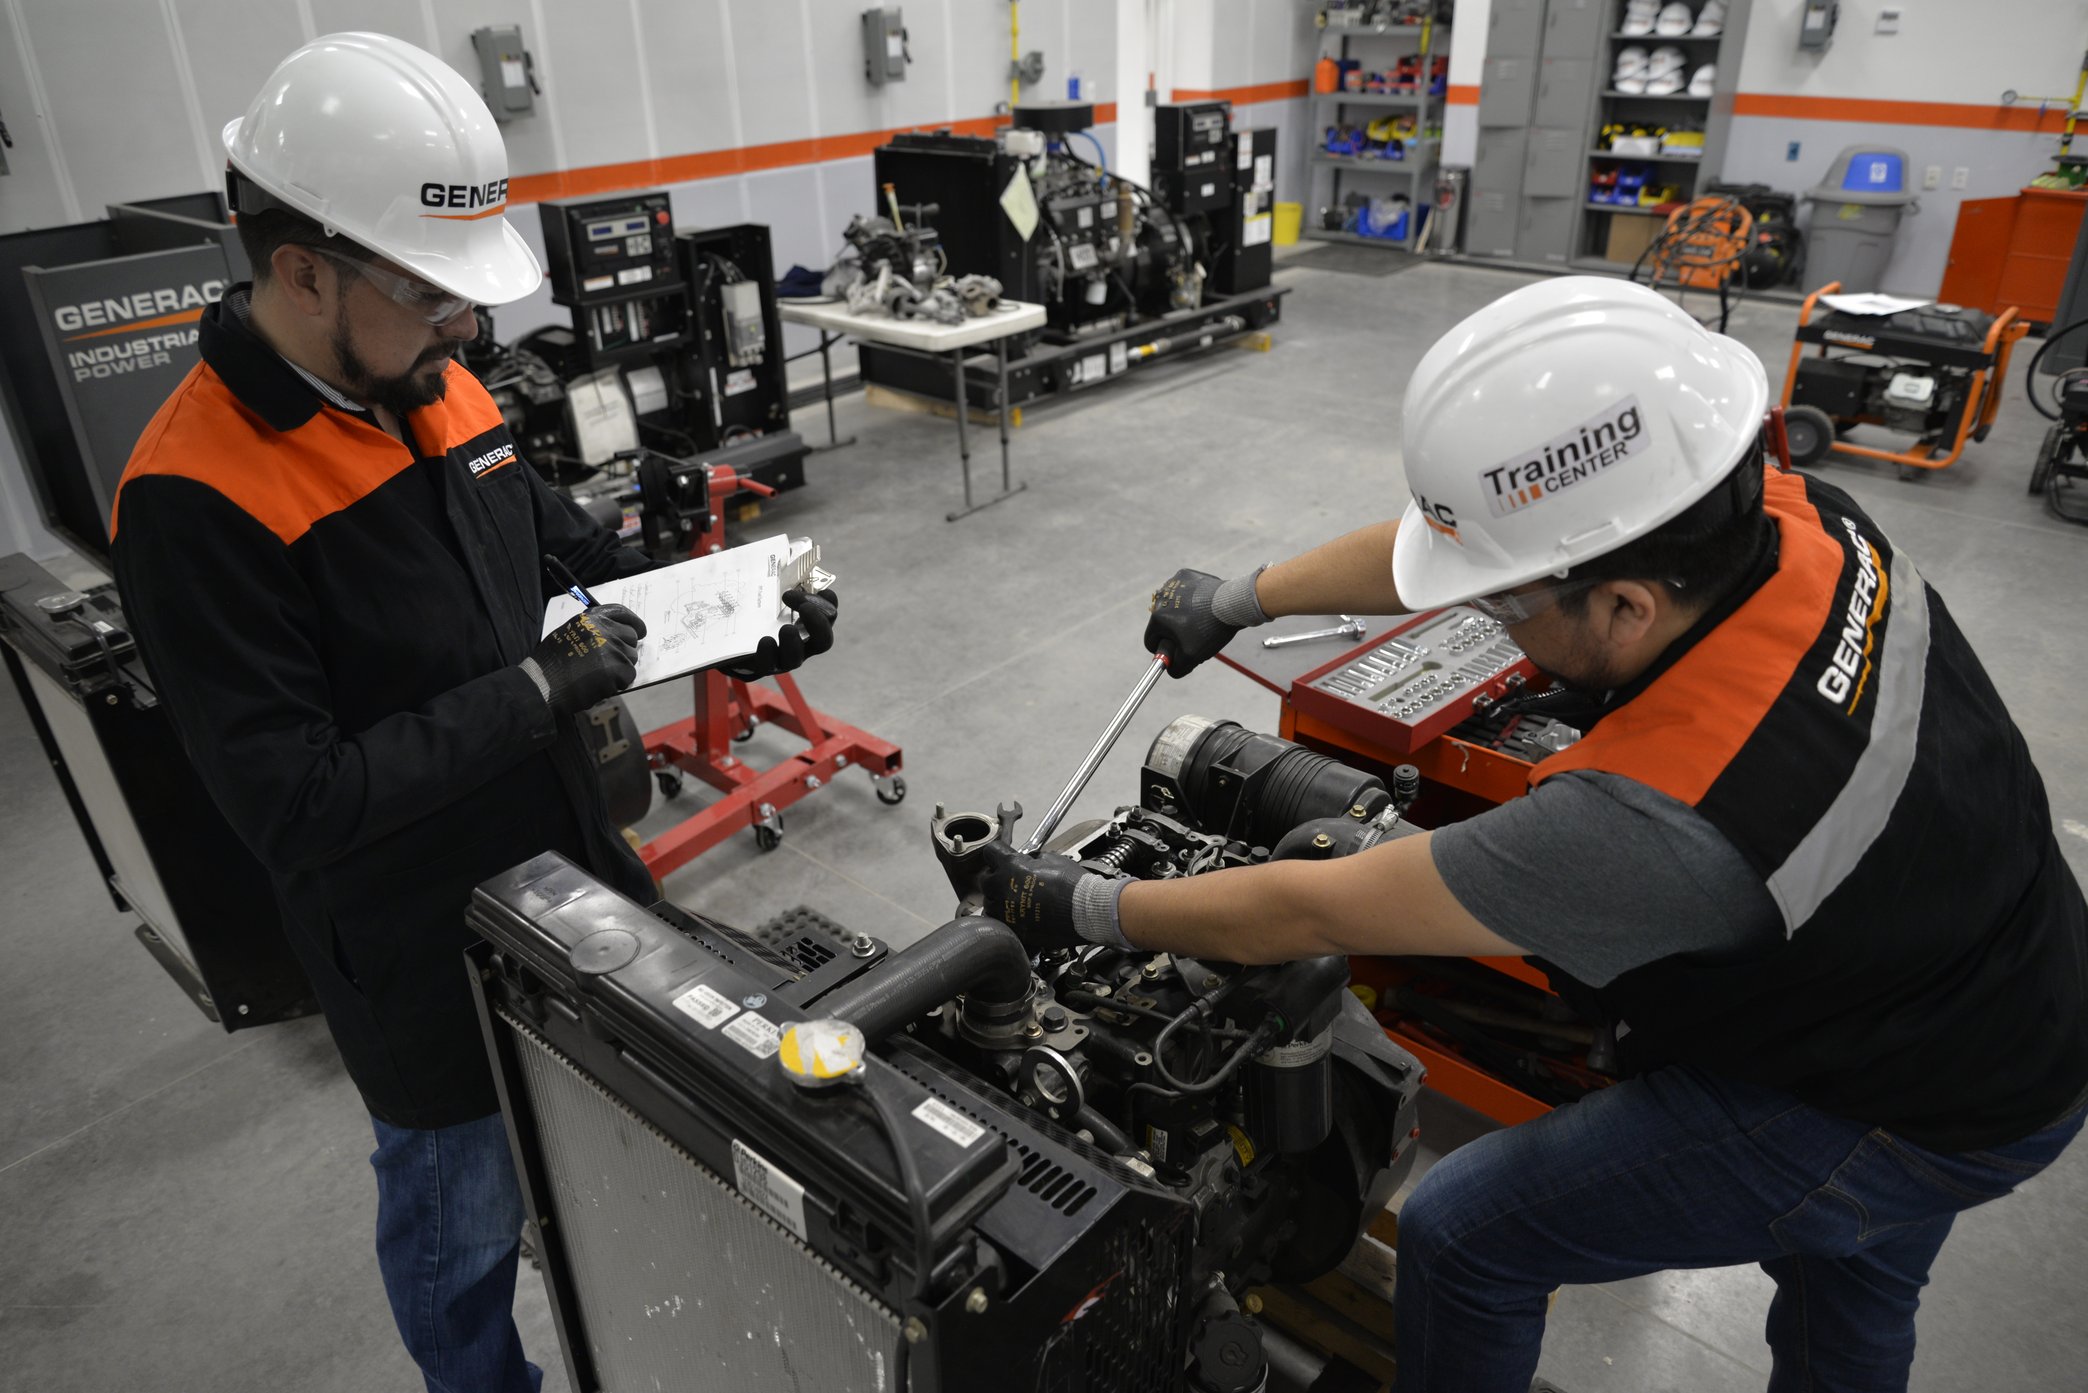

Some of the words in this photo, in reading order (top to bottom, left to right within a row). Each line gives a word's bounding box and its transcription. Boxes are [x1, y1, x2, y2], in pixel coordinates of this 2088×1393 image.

[421, 178, 509, 208] GENER
[55, 280, 225, 331] GENERAC
[69, 329, 200, 368] INDUSTRIA
[74, 352, 171, 382] POWER
[468, 443, 514, 474] GENERAC
[1484, 406, 1641, 496] Training
[1545, 442, 1628, 492] CENTER
[1420, 495, 1457, 528] AC
[1024, 875, 1032, 889] 600
[752, 1018, 777, 1034] PERKI
